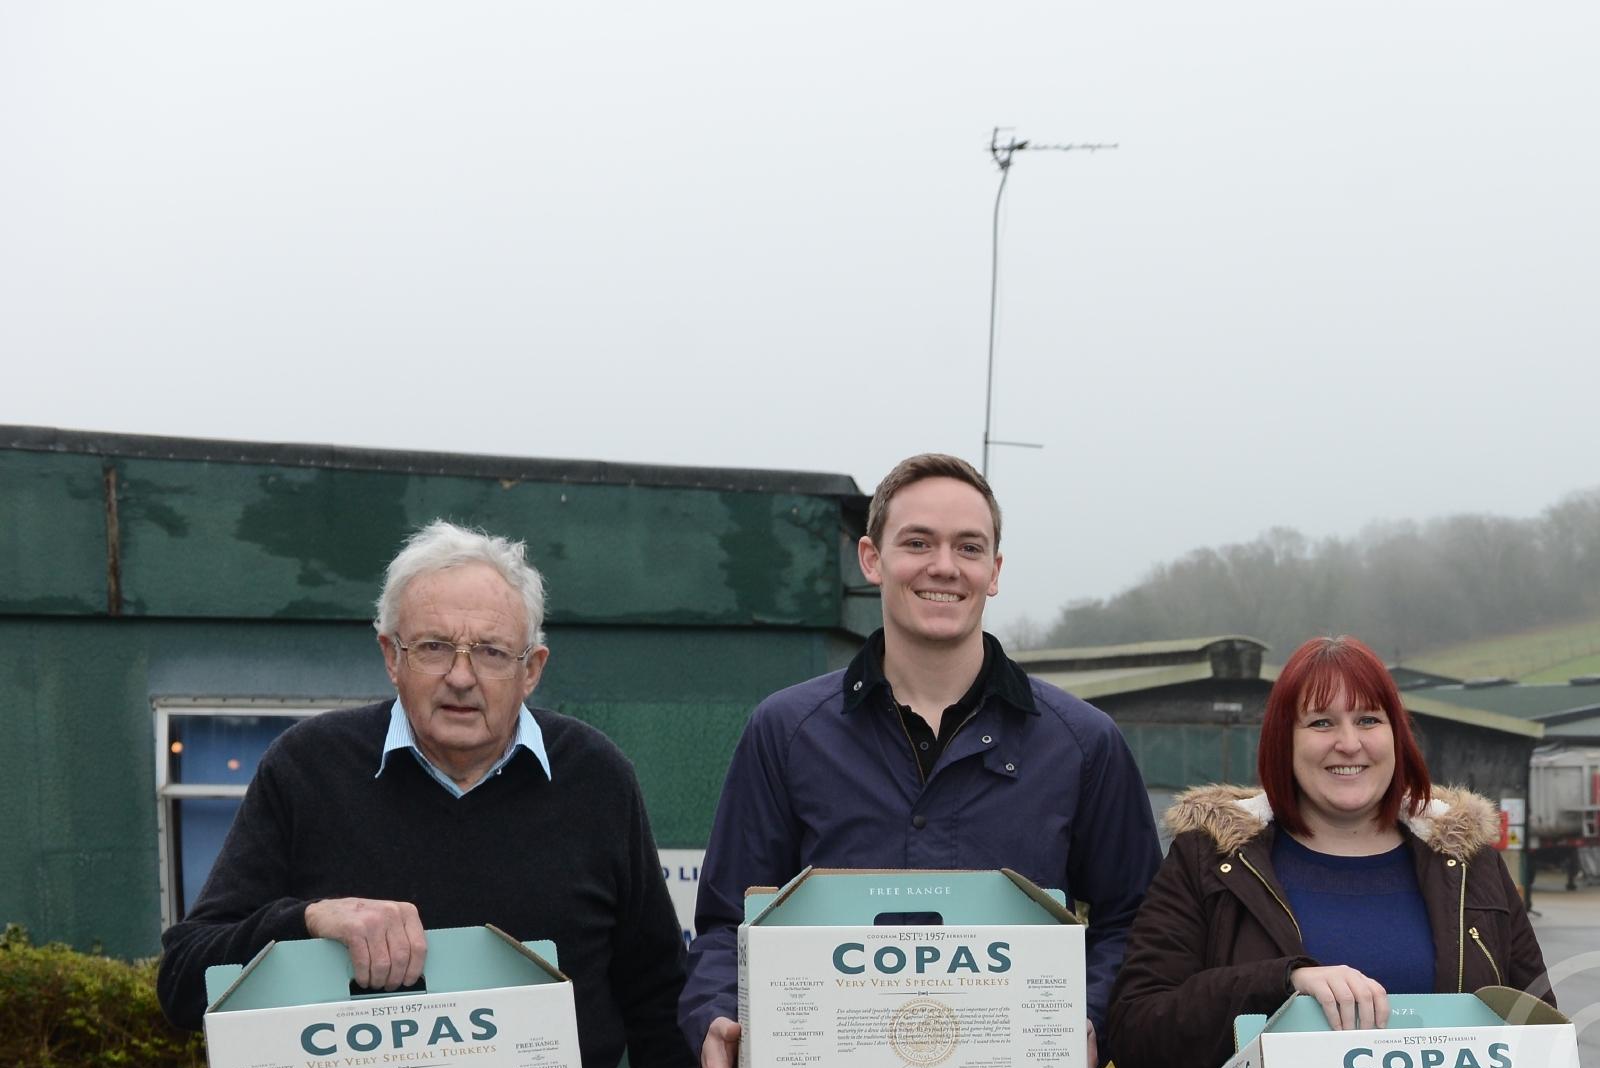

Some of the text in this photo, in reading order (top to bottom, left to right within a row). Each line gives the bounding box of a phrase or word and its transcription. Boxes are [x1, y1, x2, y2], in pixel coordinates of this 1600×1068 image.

[869, 886, 952, 896] FREE RANGE
[925, 931, 946, 941] 1957
[832, 941, 1012, 975] COPAS
[835, 976, 1009, 988] VERY VERY SPECIAL TURKEYS
[400, 1003, 423, 1014] 1957
[300, 1007, 497, 1056] COPAS
[1428, 1034, 1448, 1044] 1957
[344, 1056, 377, 1067] VERY
[382, 1050, 436, 1063] SPECIAL
[439, 1044, 497, 1057] TURKEYS
